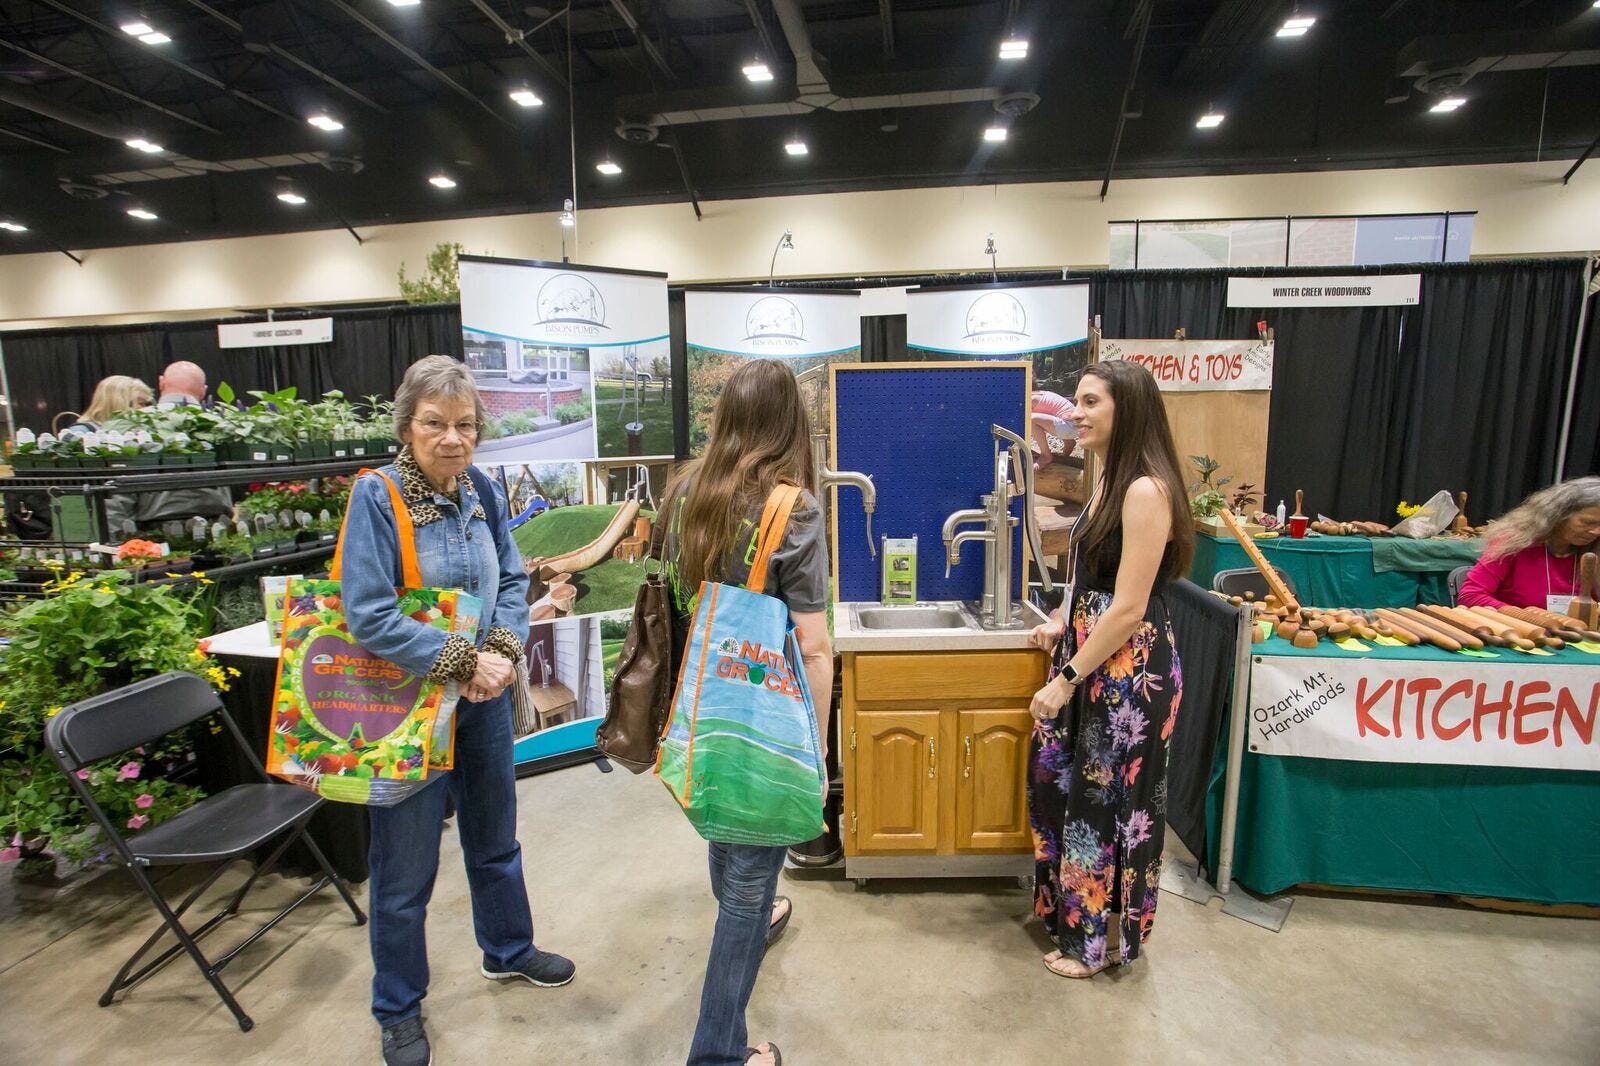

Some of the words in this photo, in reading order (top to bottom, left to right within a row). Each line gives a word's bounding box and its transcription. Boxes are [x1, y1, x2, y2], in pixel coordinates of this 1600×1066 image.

[1273, 288, 1299, 297] WINTER
[1301, 287, 1323, 296] CREEK
[1324, 286, 1371, 296] WOODWORKS
[1189, 354, 1199, 383] &
[1206, 354, 1242, 381] TOYS
[1245, 354, 1266, 372] Designs
[334, 654, 401, 669] NATURA
[311, 701, 407, 713] HEADQUARTERS
[1253, 689, 1304, 722] Ozark
[1303, 672, 1333, 693] Mt.
[1259, 682, 1345, 741] Hardwoods
[1355, 677, 1600, 747] KITCHEN
